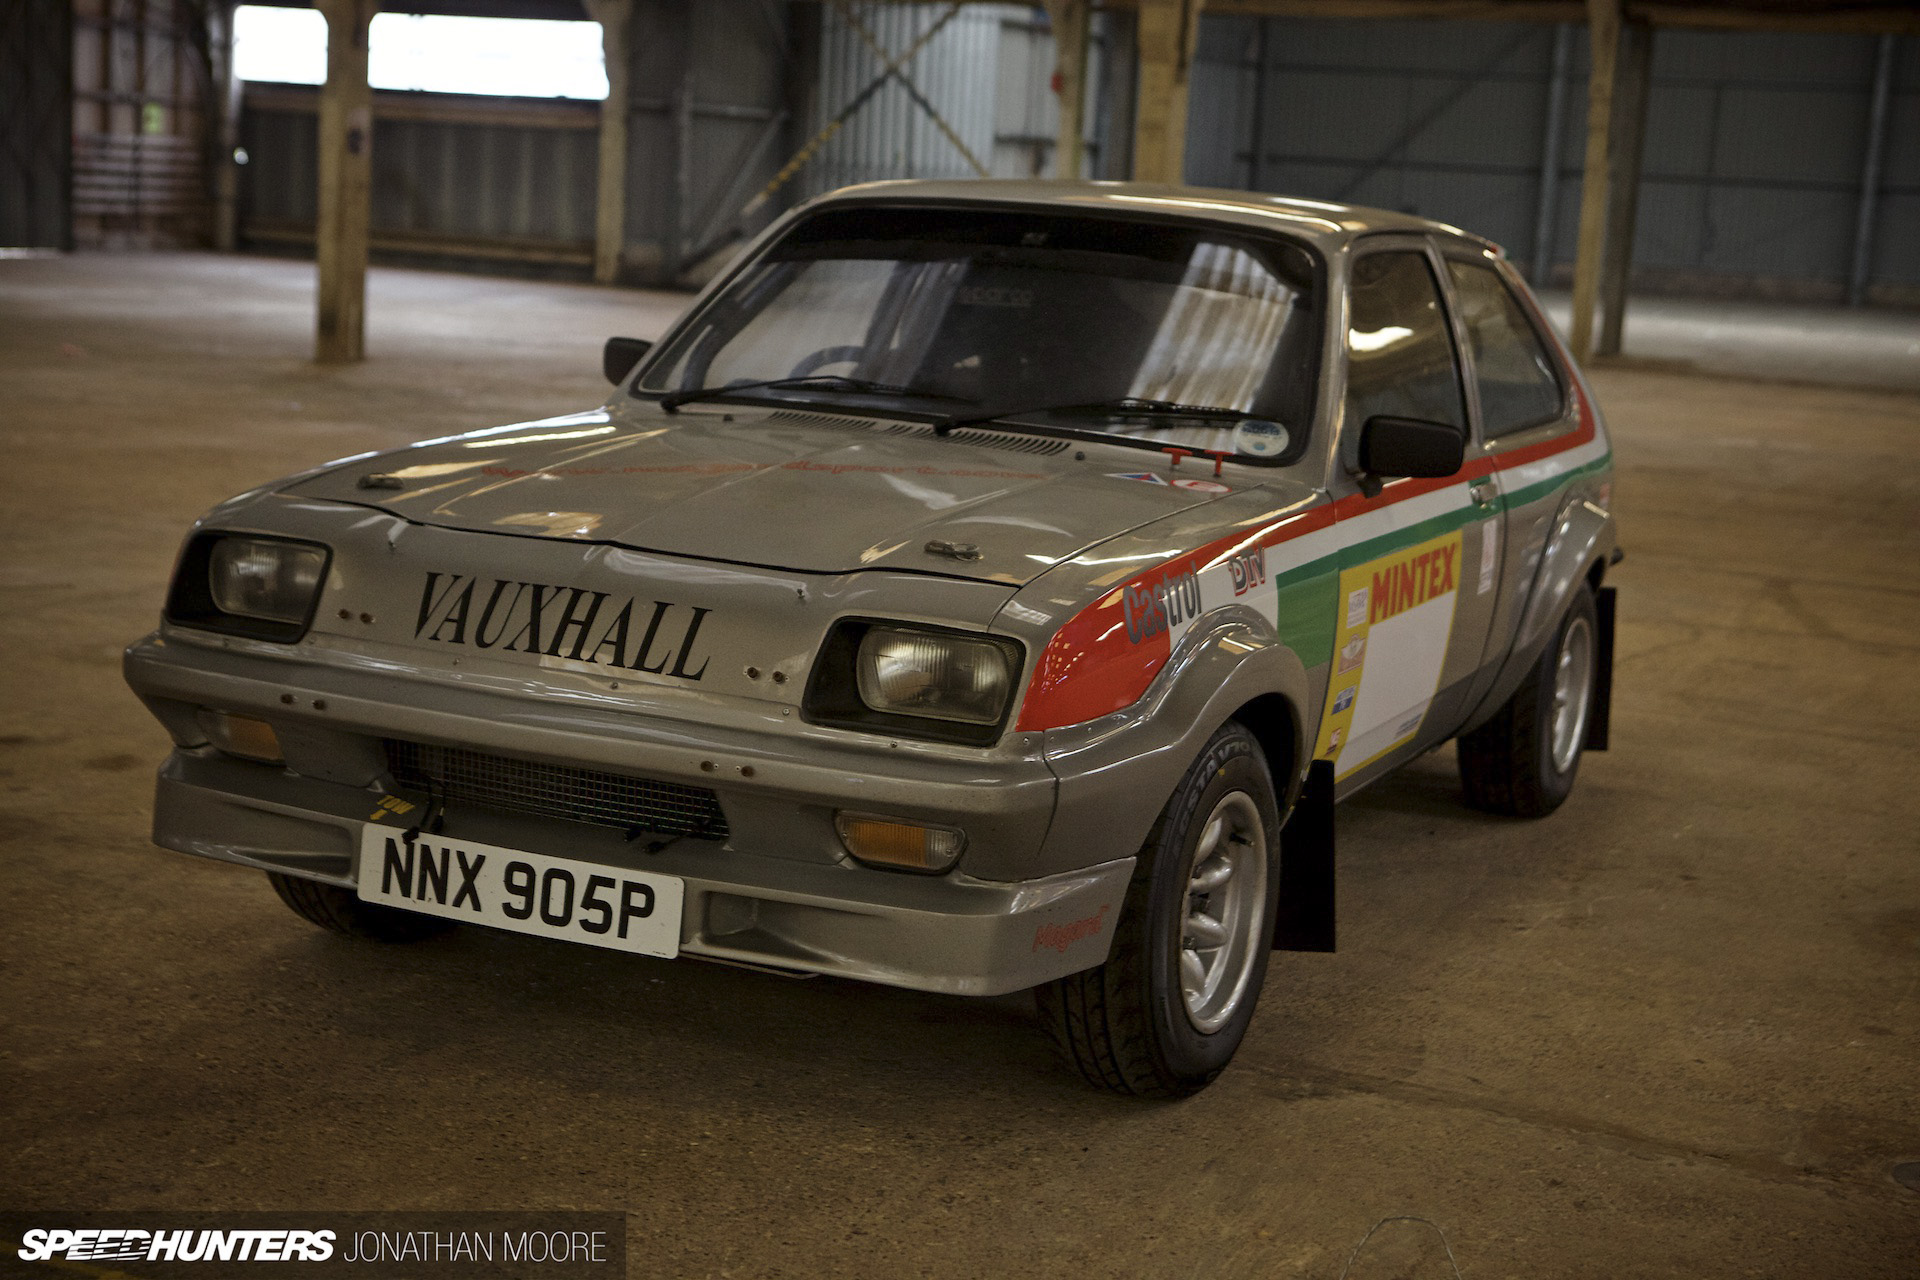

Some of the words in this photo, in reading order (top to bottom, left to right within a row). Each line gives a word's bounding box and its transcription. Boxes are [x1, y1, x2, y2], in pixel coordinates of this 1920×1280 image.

[414, 571, 713, 681] VAUXHALL
[1122, 560, 1202, 645] Castrol
[1370, 542, 1457, 625] MINTEX
[381, 837, 486, 912] NNX
[502, 860, 656, 939] 905P
